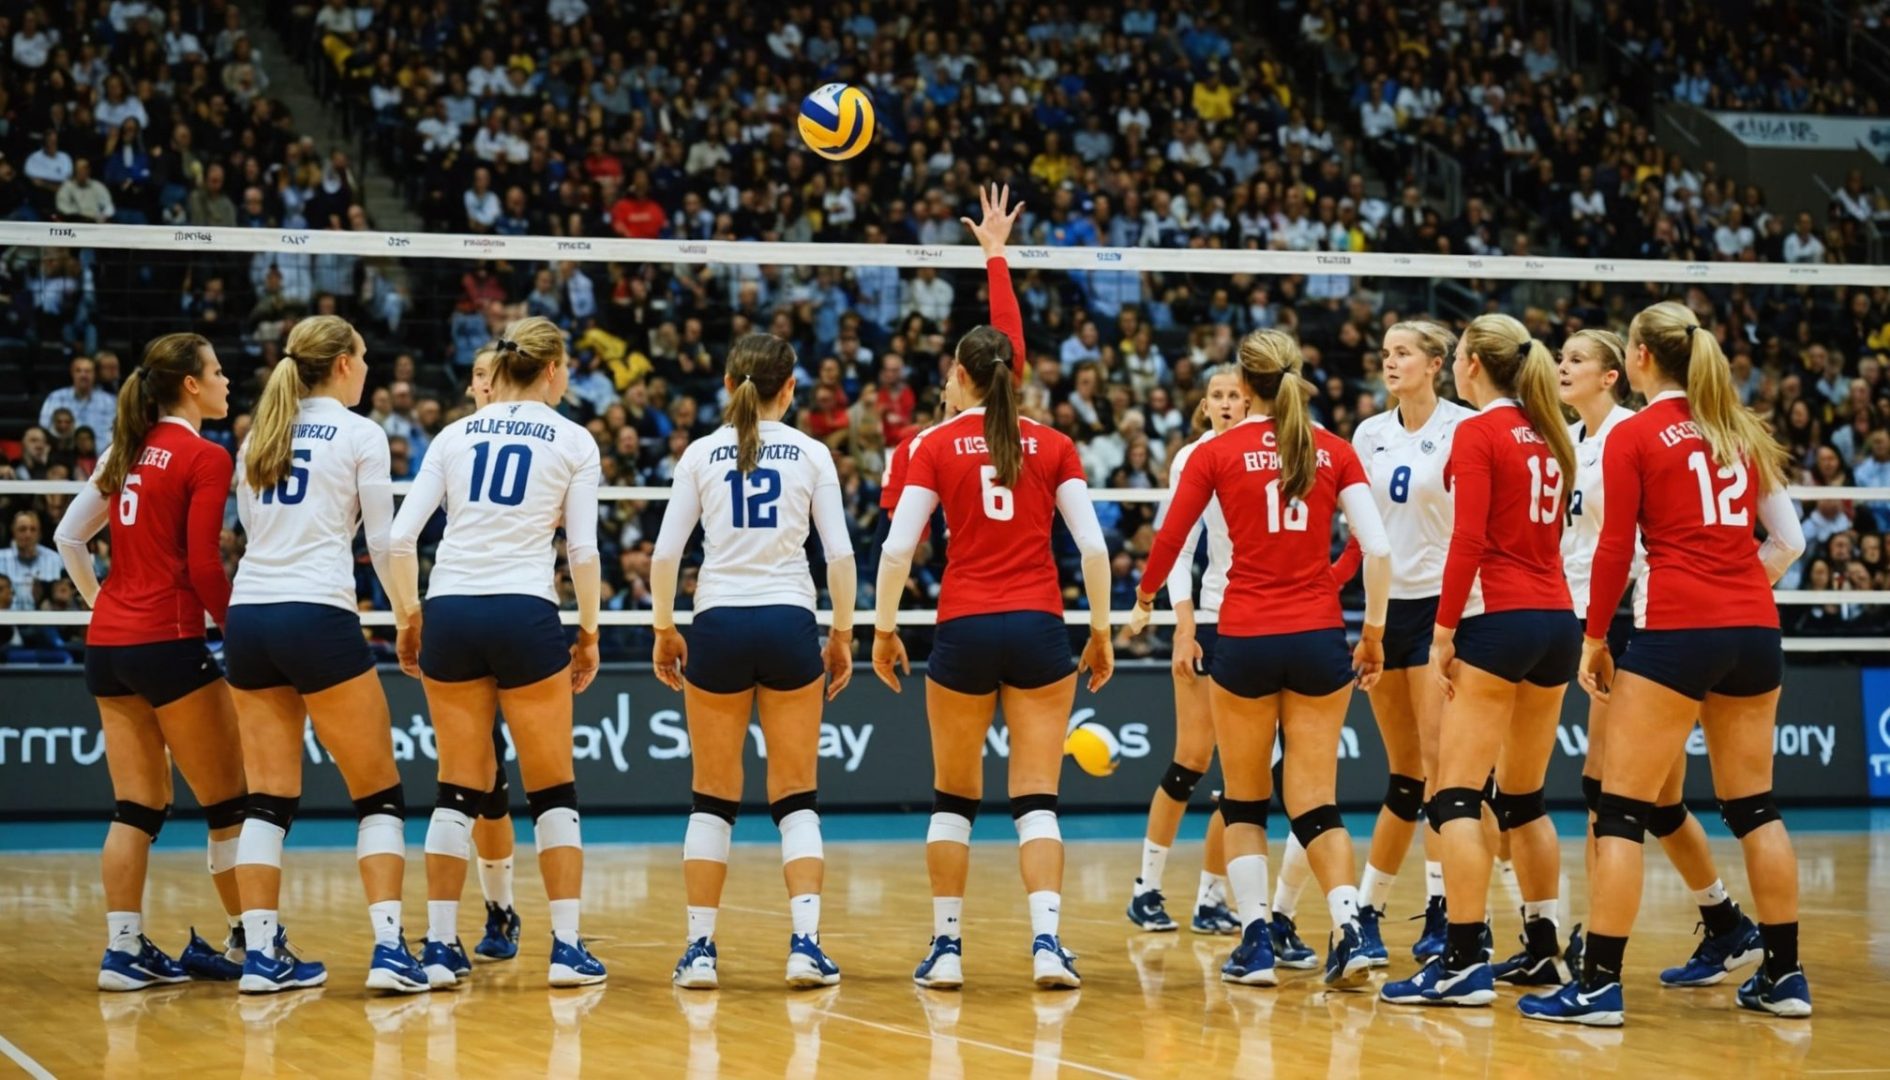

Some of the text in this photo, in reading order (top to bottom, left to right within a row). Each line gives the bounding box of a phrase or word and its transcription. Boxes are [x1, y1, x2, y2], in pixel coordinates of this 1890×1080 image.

[119, 473, 142, 526] 6
[469, 441, 533, 506] 10
[724, 467, 781, 528] 12
[980, 465, 1014, 521] 6
[1389, 465, 1411, 503] 8
[1688, 451, 1748, 526] 12
